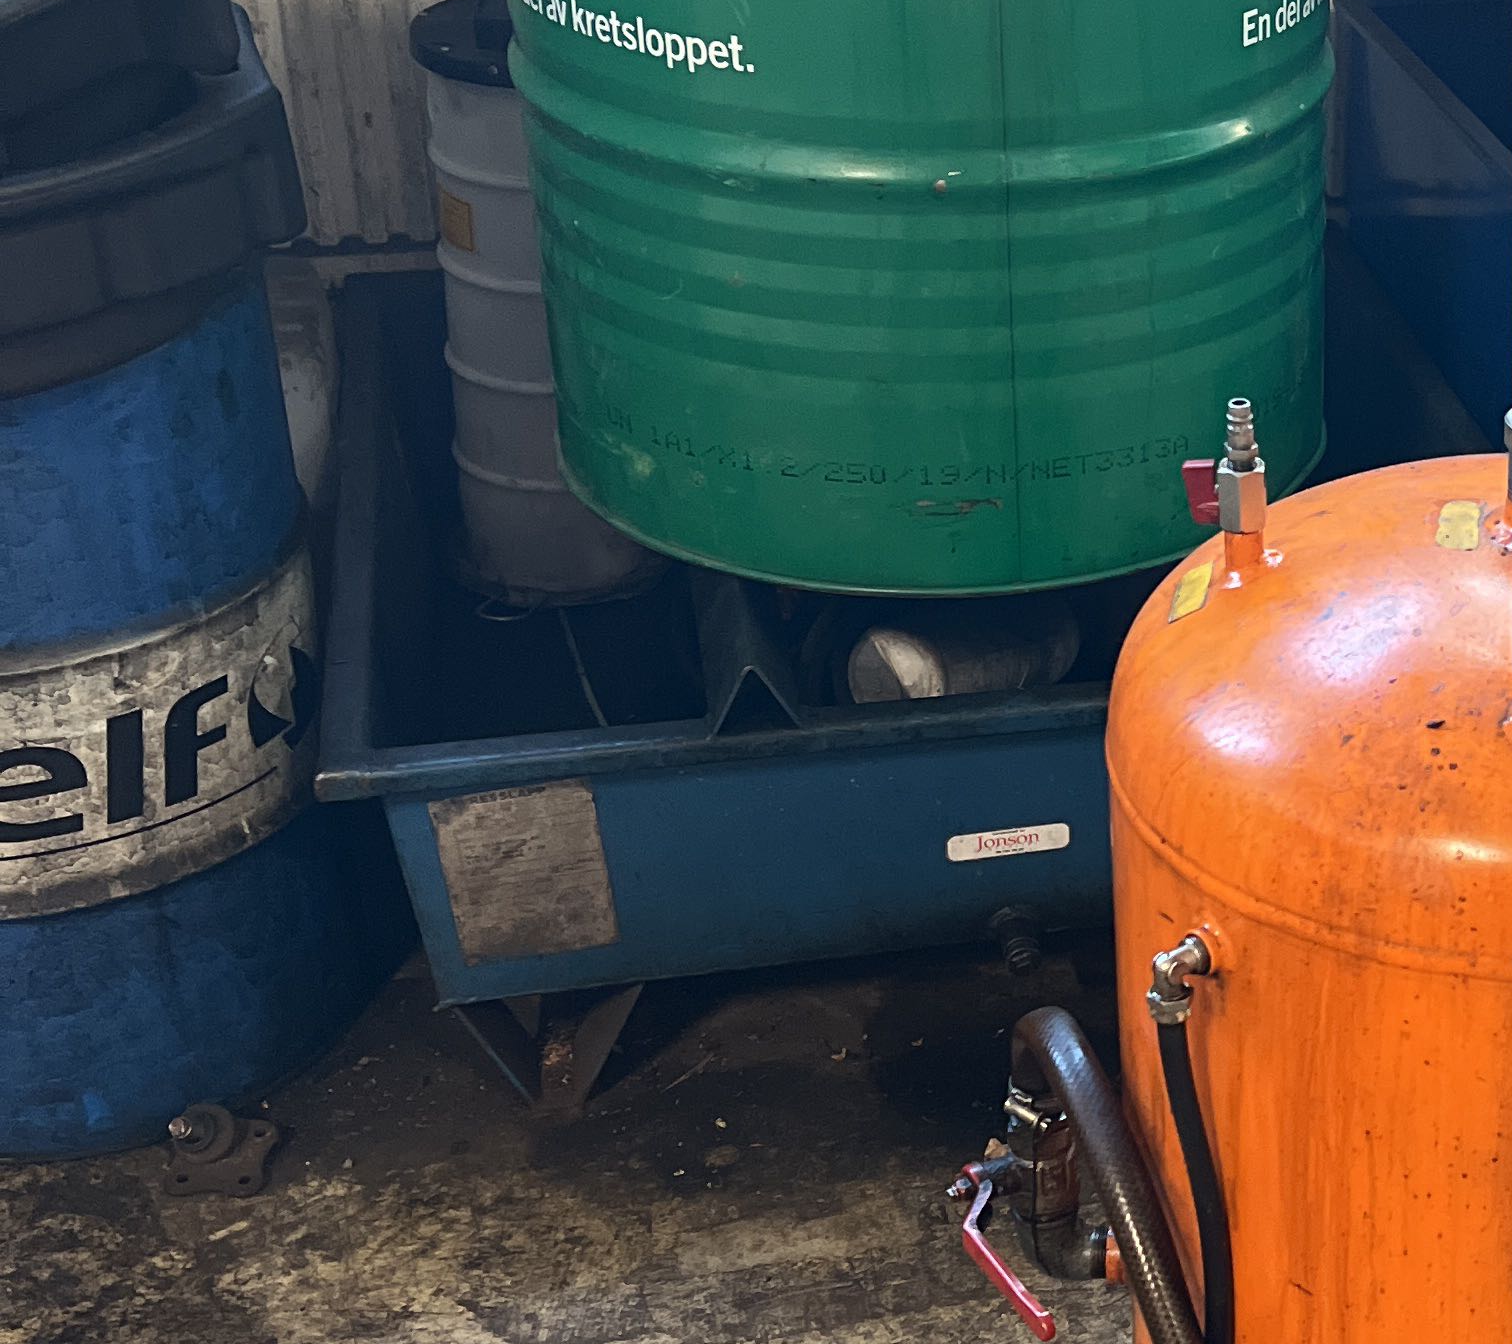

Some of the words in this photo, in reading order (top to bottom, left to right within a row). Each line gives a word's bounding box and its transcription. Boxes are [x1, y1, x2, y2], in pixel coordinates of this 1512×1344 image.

[1242, 8, 1271, 48] En
[0, 674, 228, 843] elf
[976, 832, 1040, 853] Jonson
